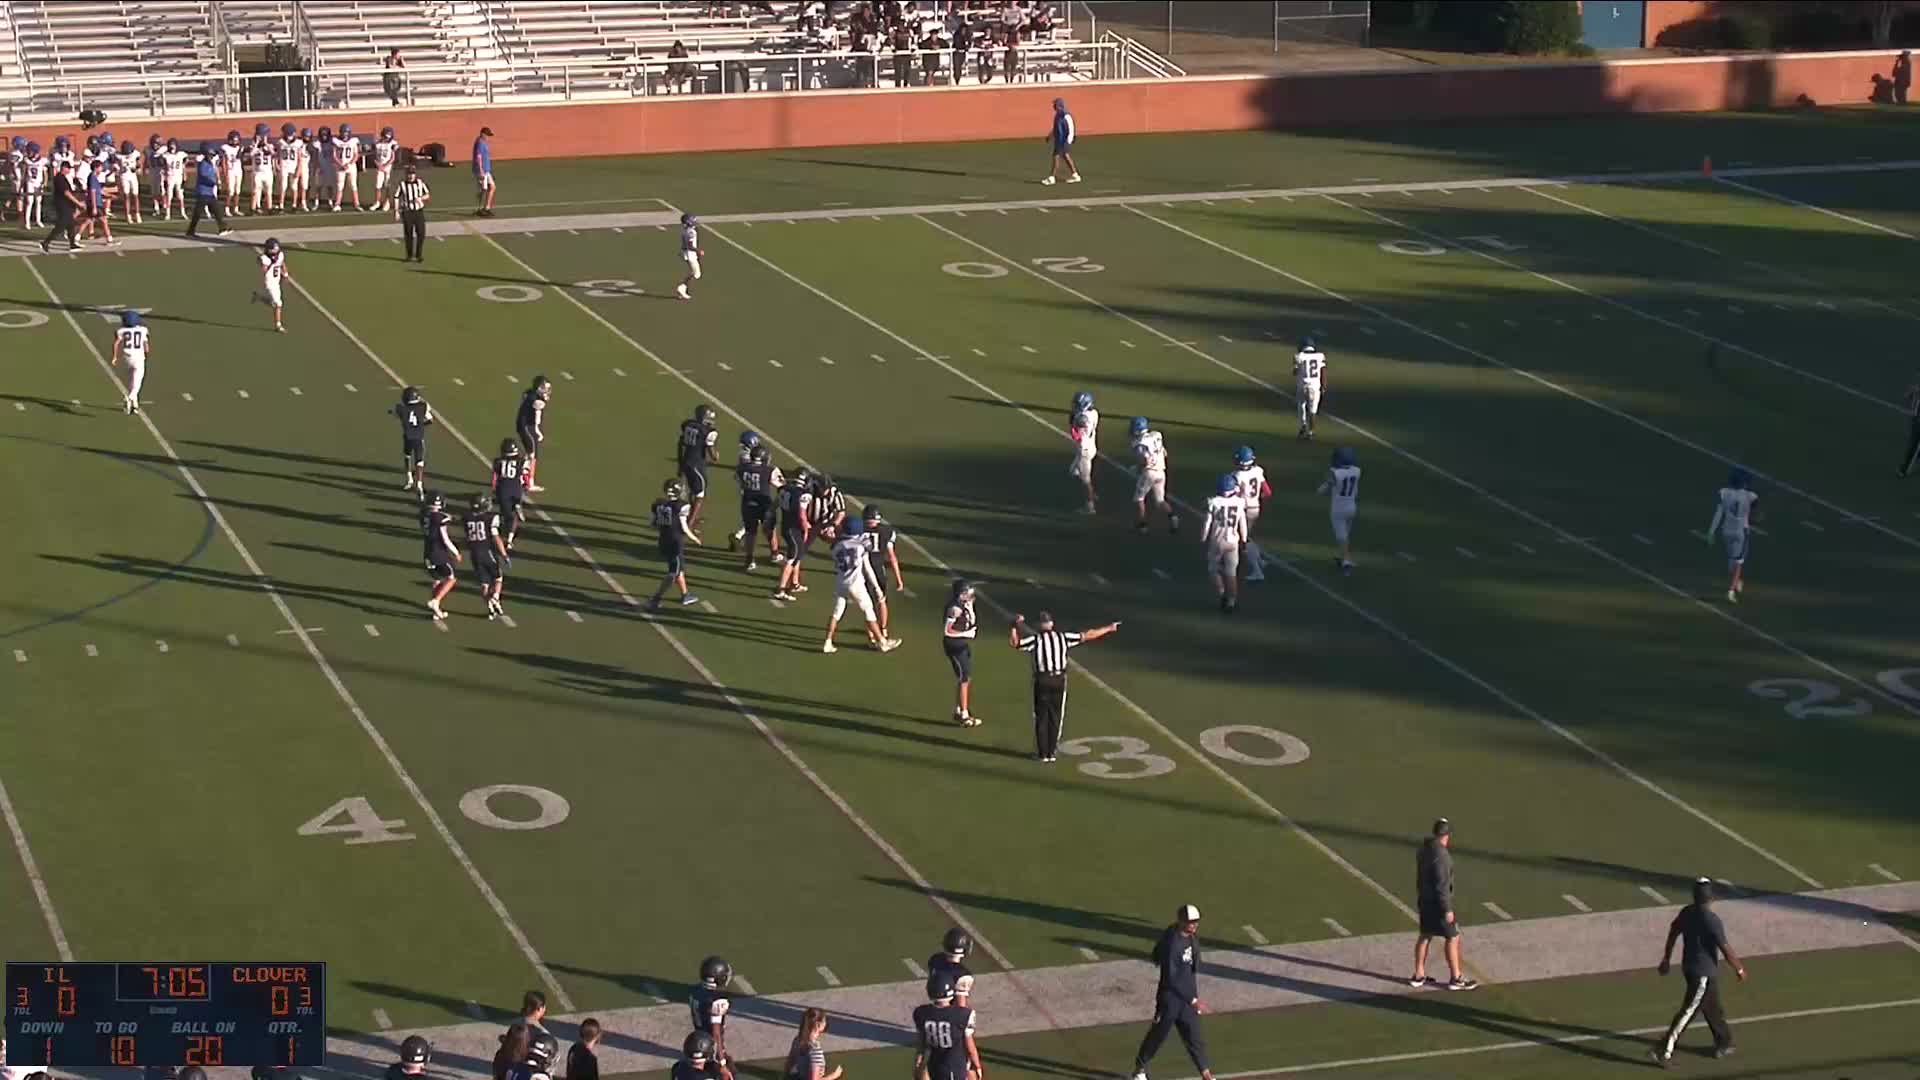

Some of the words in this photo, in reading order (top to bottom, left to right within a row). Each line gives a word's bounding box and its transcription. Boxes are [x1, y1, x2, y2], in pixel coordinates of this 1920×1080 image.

[123, 331, 143, 350] 20
[1300, 358, 1319, 379] 12
[409, 410, 418, 427] 4
[500, 459, 518, 480] 16
[1340, 476, 1357, 498] 11
[1214, 505, 1238, 528] 45
[466, 521, 487, 542] 28
